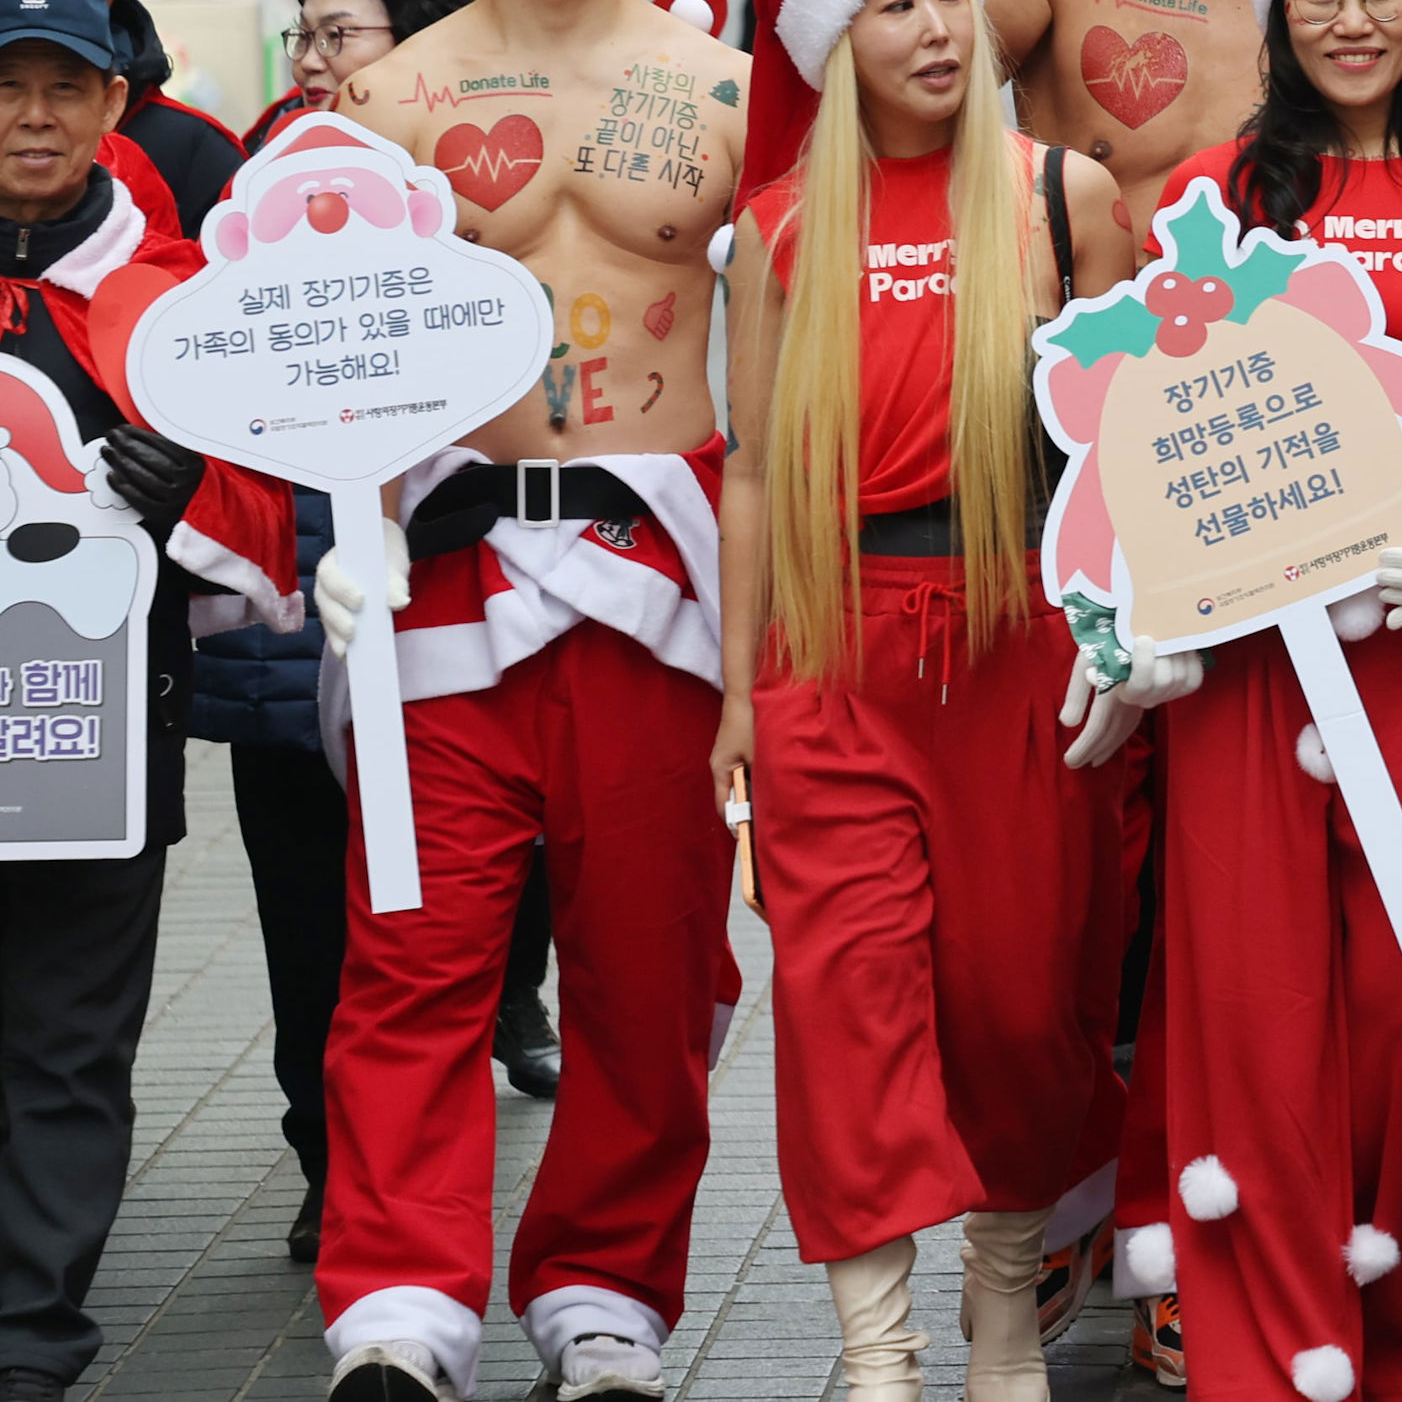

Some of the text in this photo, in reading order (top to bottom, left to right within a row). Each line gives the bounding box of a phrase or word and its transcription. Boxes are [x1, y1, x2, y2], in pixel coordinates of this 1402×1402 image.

[459, 71, 550, 94] Donate Life
[627, 62, 696, 100] 사랑의
[609, 87, 699, 131] 장기기증
[595, 118, 701, 162] 끝이 아닌
[573, 146, 705, 198] 또 다른 시작
[238, 266, 434, 316] 실제 장기기증은
[174, 297, 506, 361] 가족의 동의가 있을 때에만
[285, 349, 401, 387] 가능해요!
[1163, 350, 1276, 415] 장기기증
[1151, 381, 1323, 465] 희망등록으로
[1164, 421, 1342, 510] 성탄의 기적을
[1194, 467, 1345, 547] 선물하세요!
[22, 660, 102, 706] 함께
